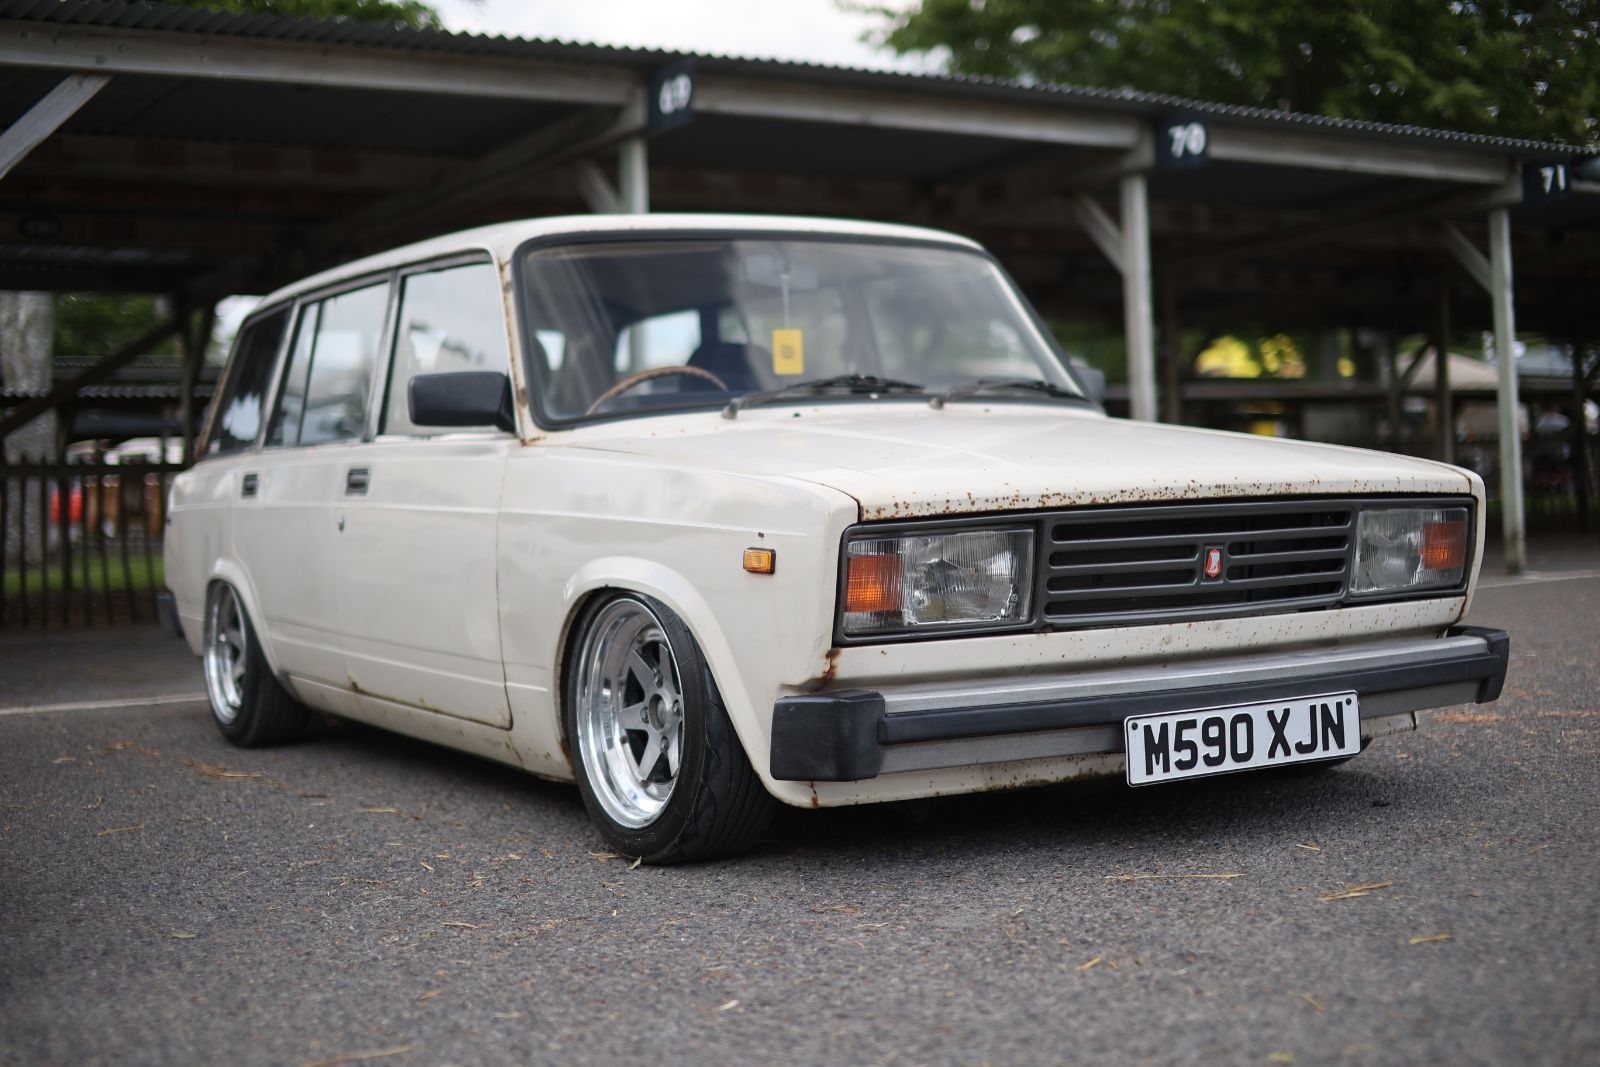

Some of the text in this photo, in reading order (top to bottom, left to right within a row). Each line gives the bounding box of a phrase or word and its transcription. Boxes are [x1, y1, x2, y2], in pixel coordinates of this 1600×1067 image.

[659, 74, 692, 115] 69
[1168, 122, 1206, 158] 70
[1540, 164, 1566, 194] 71
[1143, 701, 1345, 776] M590 XJN
